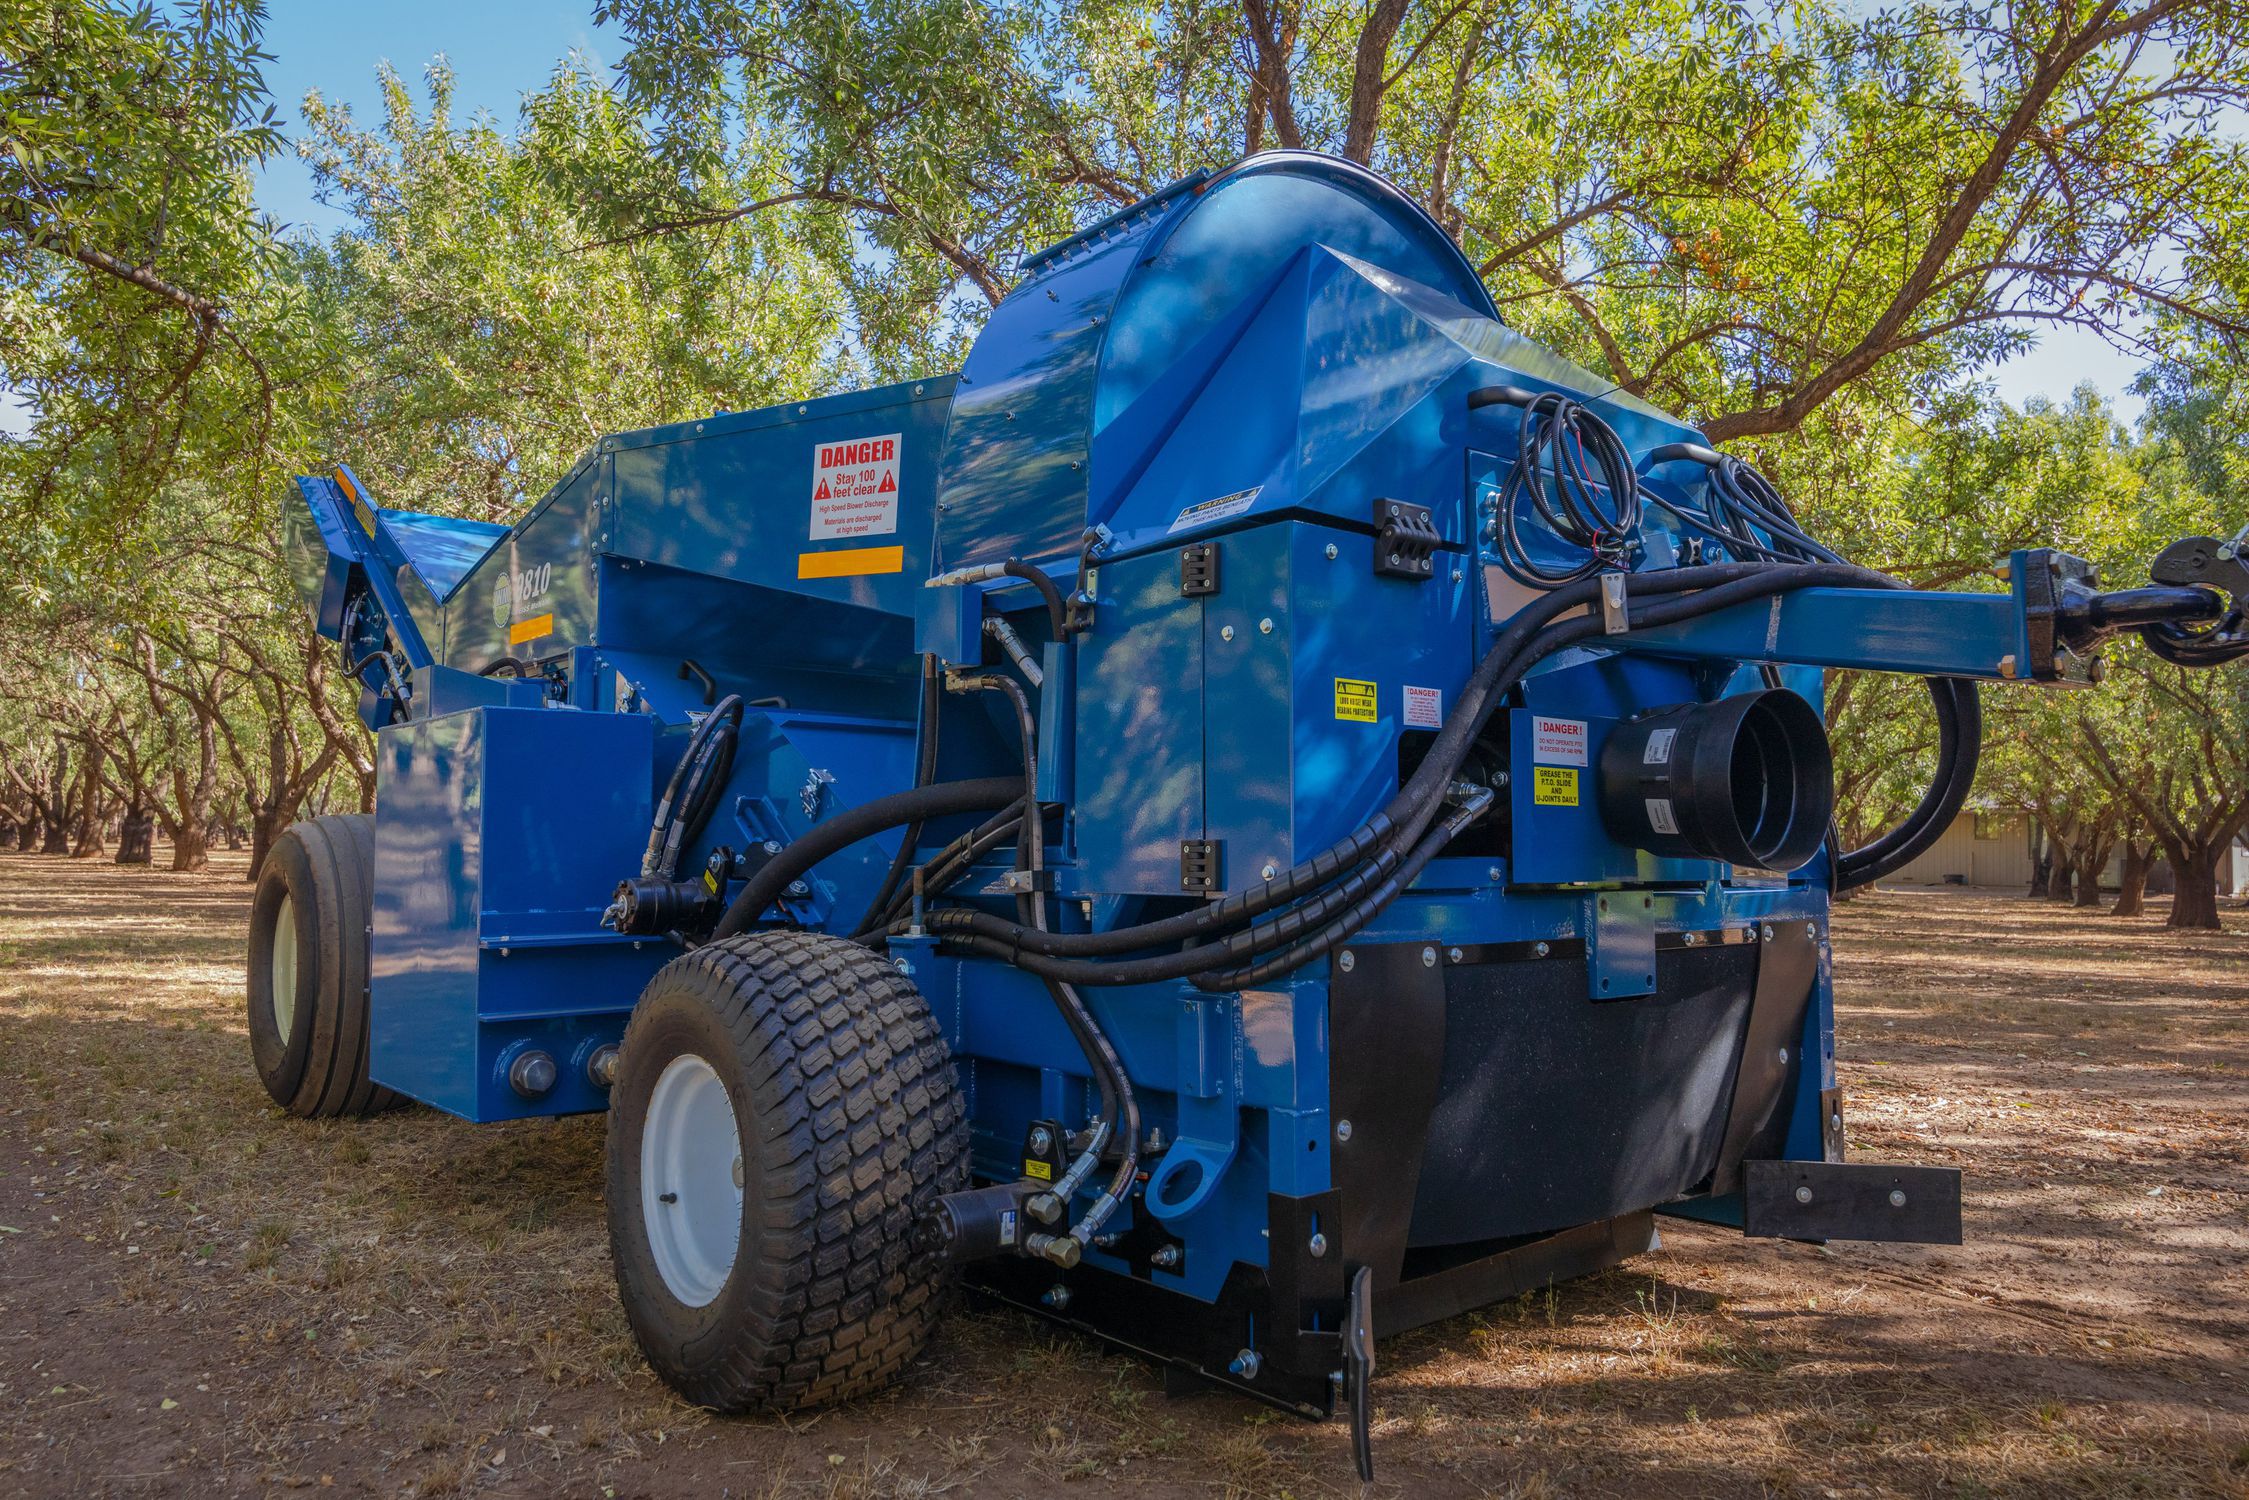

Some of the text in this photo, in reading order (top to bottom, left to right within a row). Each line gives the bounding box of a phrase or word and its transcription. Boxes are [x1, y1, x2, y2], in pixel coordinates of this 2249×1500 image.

[821, 440, 894, 469] DANGER
[836, 469, 875, 487] Stay 100
[834, 483, 877, 498] feet clear
[831, 504, 846, 512] Speed
[847, 502, 864, 510] Blower
[864, 500, 889, 508] Discharge
[1197, 493, 1243, 511] WARNING
[855, 514, 882, 523] discharged
[842, 526, 853, 535] high
[853, 524, 868, 533] speed
[514, 562, 551, 601] 9810
[1540, 770, 1573, 779] GREASE THE
[1556, 779, 1572, 787] SLIDE
[1551, 787, 1563, 795] AND
[1535, 795, 1577, 804] U-JOINTS DAILY
